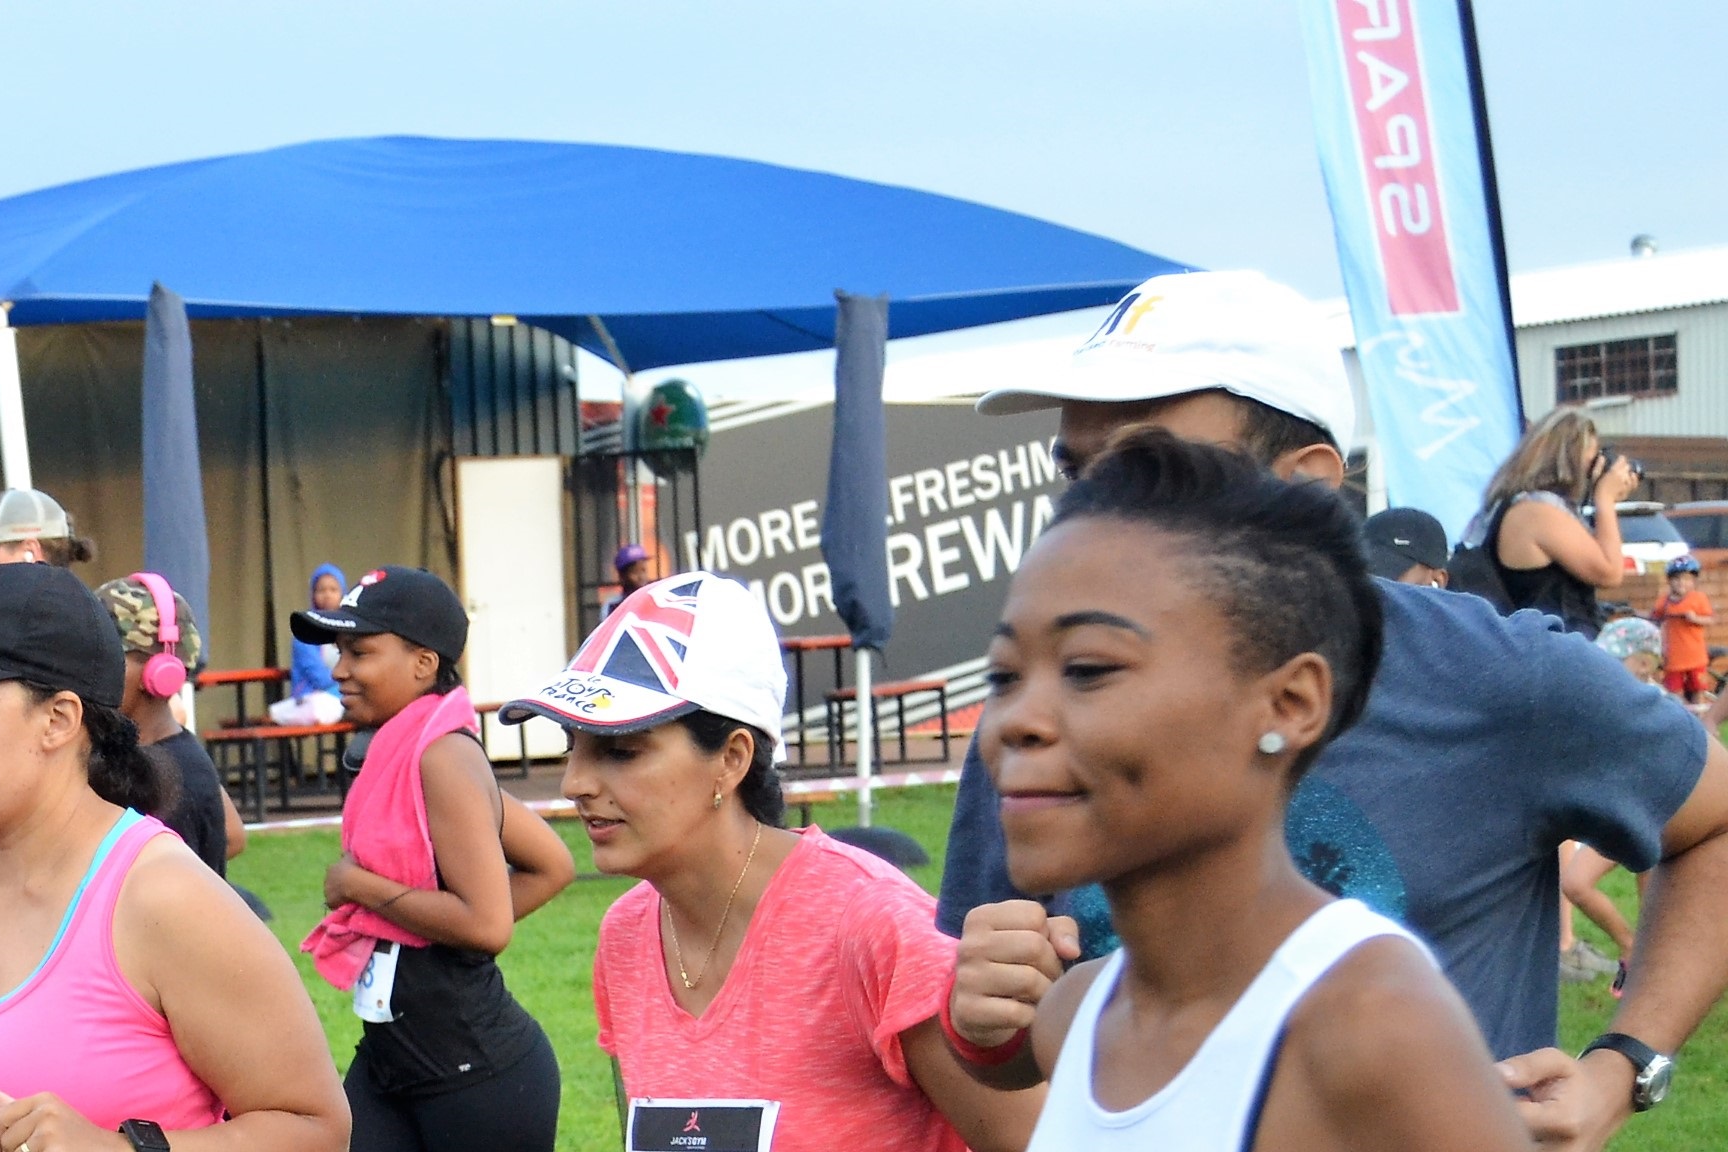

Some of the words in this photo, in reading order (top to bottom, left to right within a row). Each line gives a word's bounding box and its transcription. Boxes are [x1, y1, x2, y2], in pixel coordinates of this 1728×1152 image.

[683, 499, 822, 572] MORE
[884, 433, 1060, 527] FRESHM
[885, 493, 1057, 608] REWA
